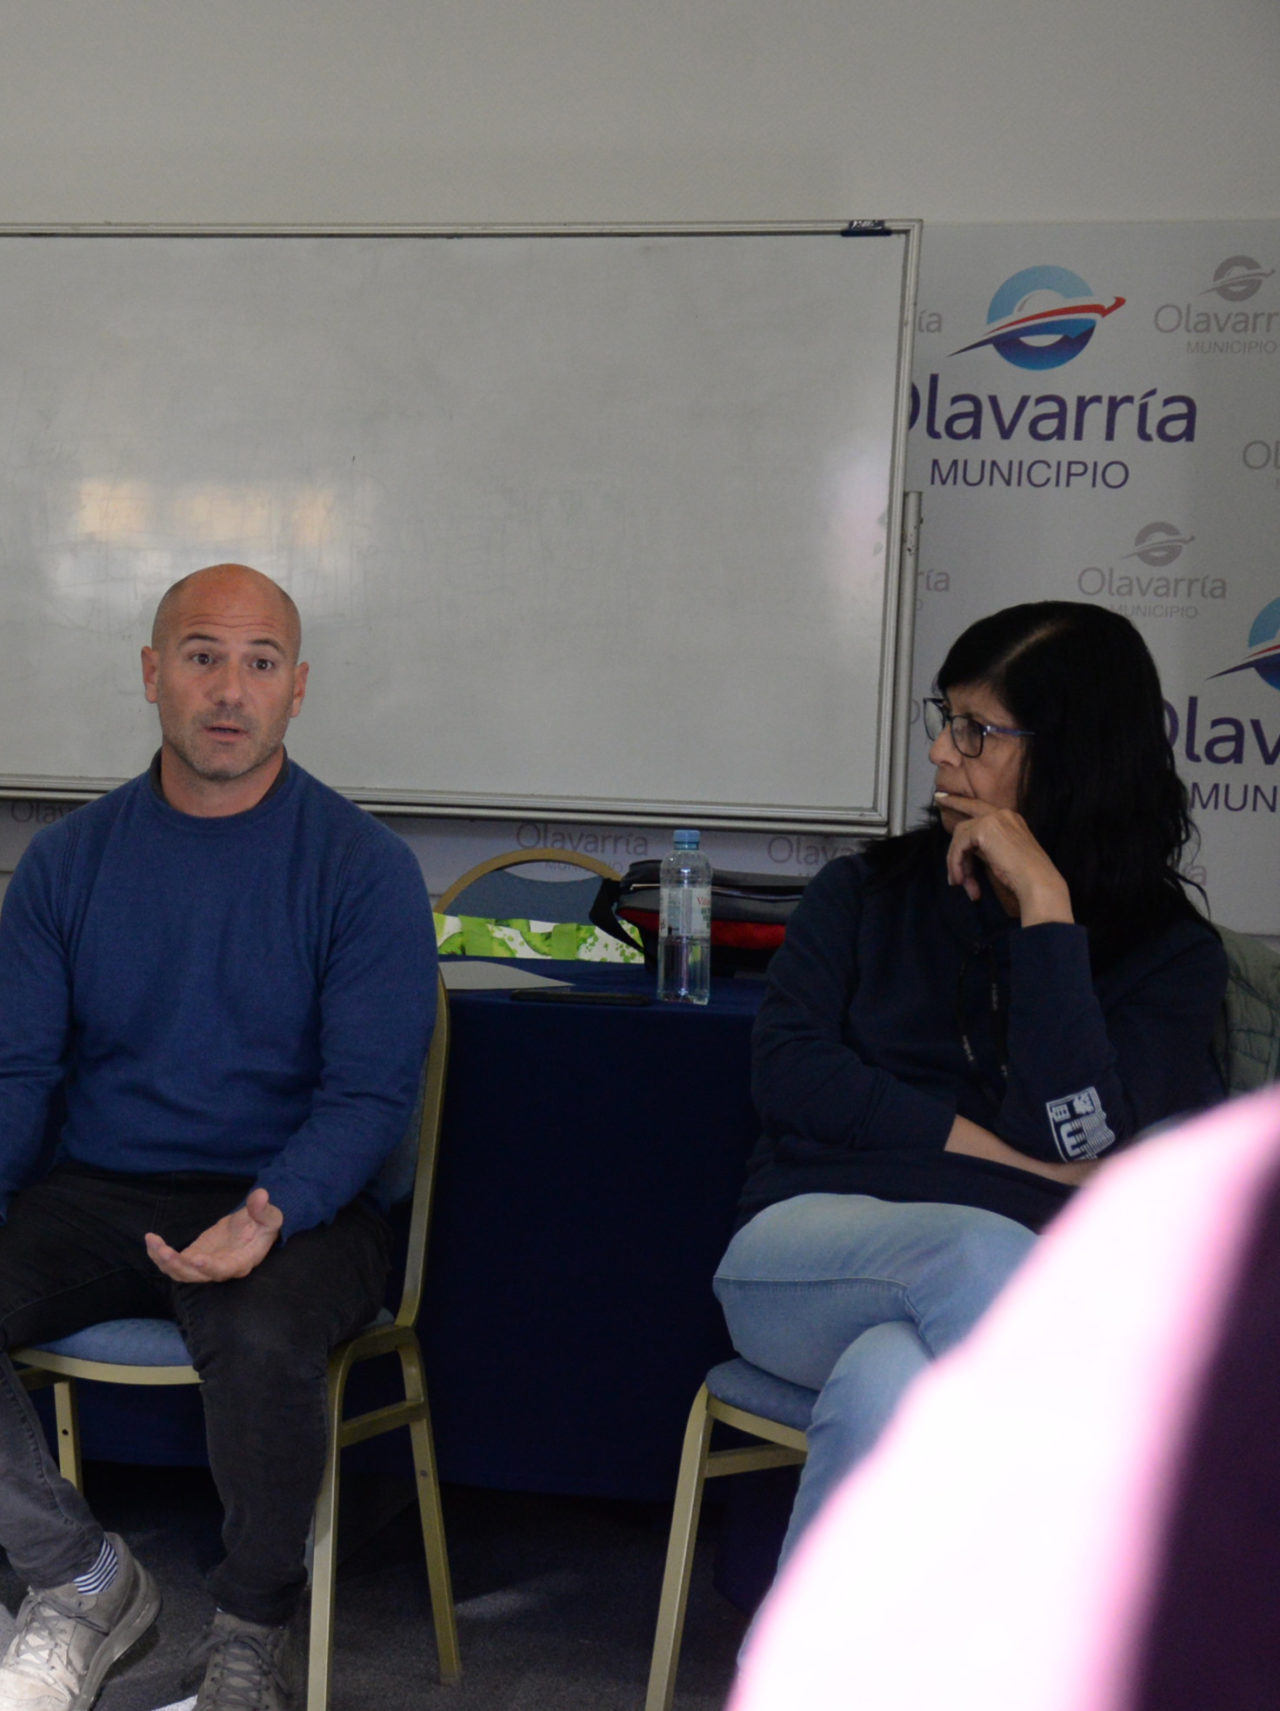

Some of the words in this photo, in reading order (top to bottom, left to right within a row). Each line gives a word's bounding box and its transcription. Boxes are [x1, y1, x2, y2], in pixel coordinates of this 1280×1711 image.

[1186, 341, 1277, 355] MUNICIPIO
[930, 459, 1130, 489] MUNICIPIO
[1077, 567, 1228, 600] Olavarría
[515, 822, 649, 857] Olavarría
